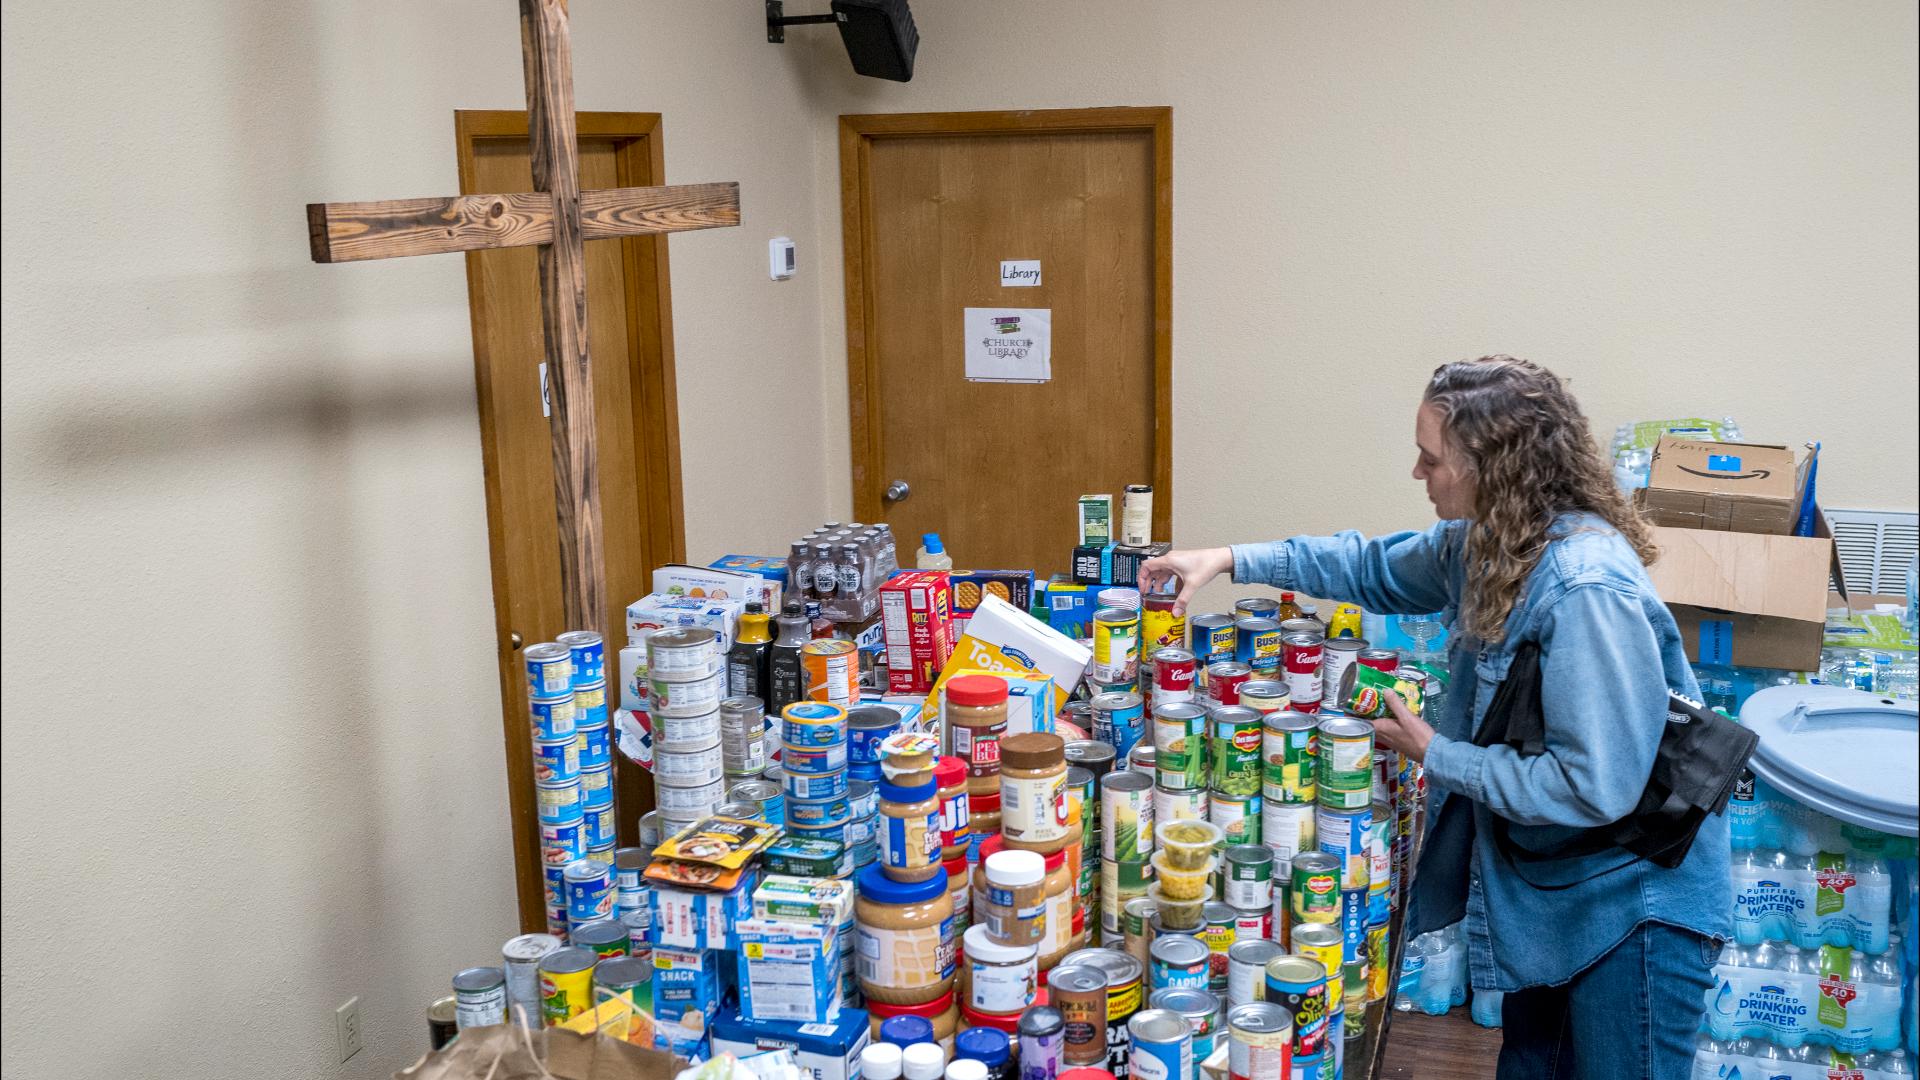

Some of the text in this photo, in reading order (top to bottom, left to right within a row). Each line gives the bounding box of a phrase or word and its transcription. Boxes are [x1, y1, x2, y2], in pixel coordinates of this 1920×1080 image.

[1003, 265, 1040, 284] Library
[988, 338, 1028, 347] CHURCH
[988, 347, 1029, 356] LIBRARY
[1077, 557, 1087, 577] COLD
[936, 588, 949, 624] RITZ
[912, 612, 929, 624] RITZ
[938, 796, 968, 831] Ji
[1737, 894, 1805, 909] DRINKING
[1747, 903, 1794, 916] WATER
[660, 971, 695, 982] SNACK
[1749, 992, 1799, 1004] PURIFIED
[1831, 987, 1847, 998] 40
[1740, 998, 1807, 1015] DRINKING
[757, 1038, 798, 1050] KIRKLAND
